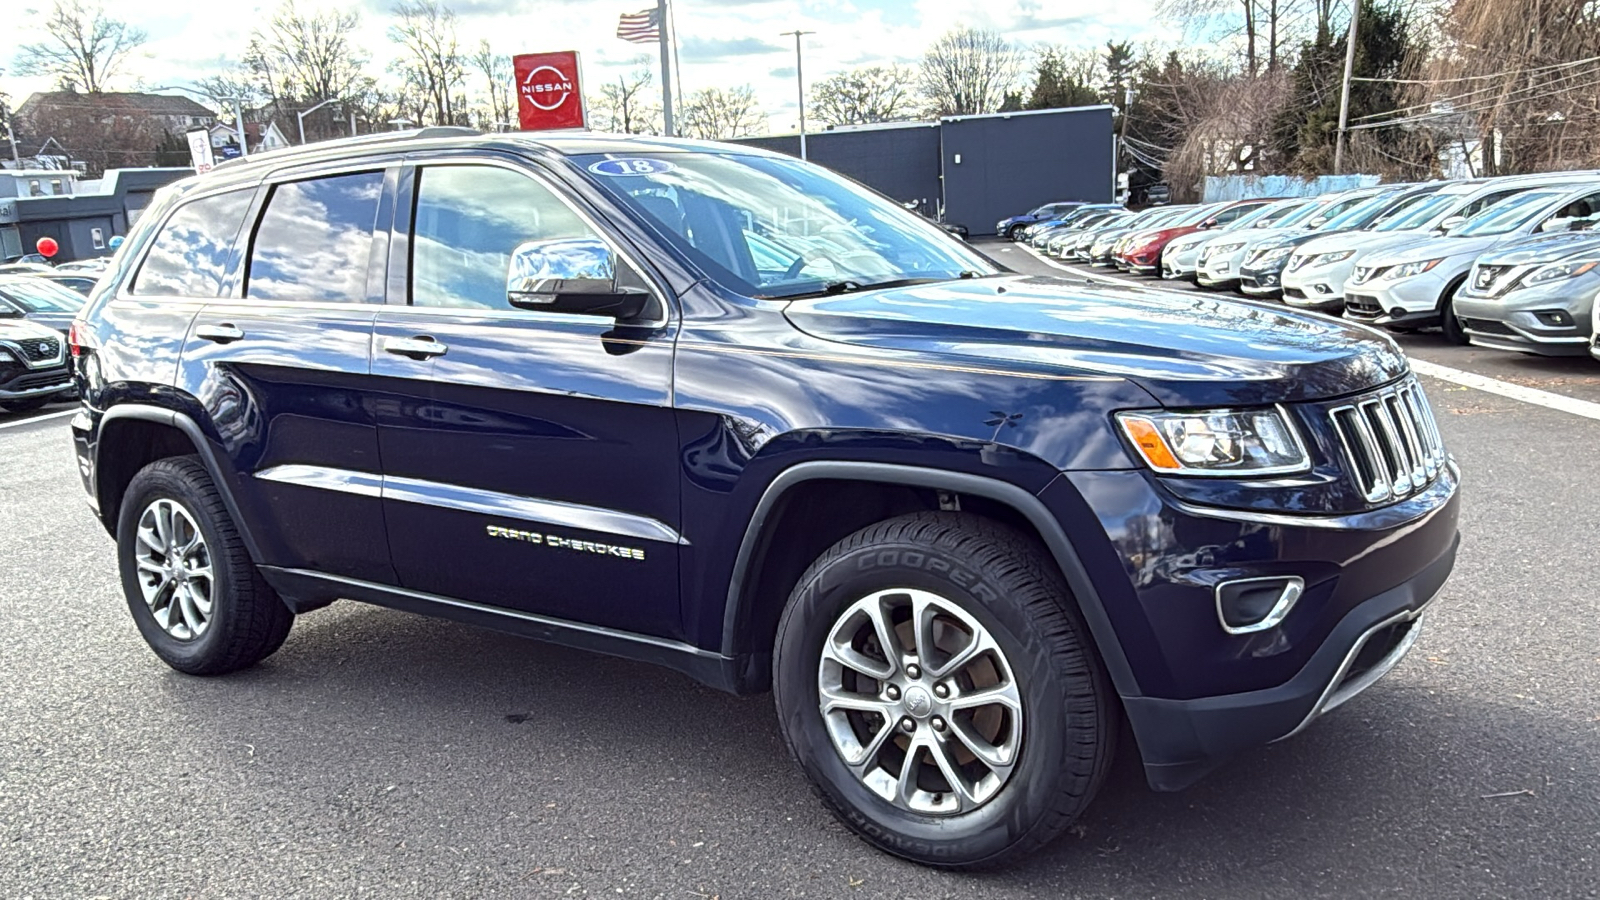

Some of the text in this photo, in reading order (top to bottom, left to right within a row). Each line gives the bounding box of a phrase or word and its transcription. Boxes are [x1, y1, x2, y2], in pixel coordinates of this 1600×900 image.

[522, 82, 572, 94] NISSAN
[616, 160, 654, 174] 18
[486, 525, 645, 560] GRAND CHEROKEE
[857, 551, 998, 603] COOPER
